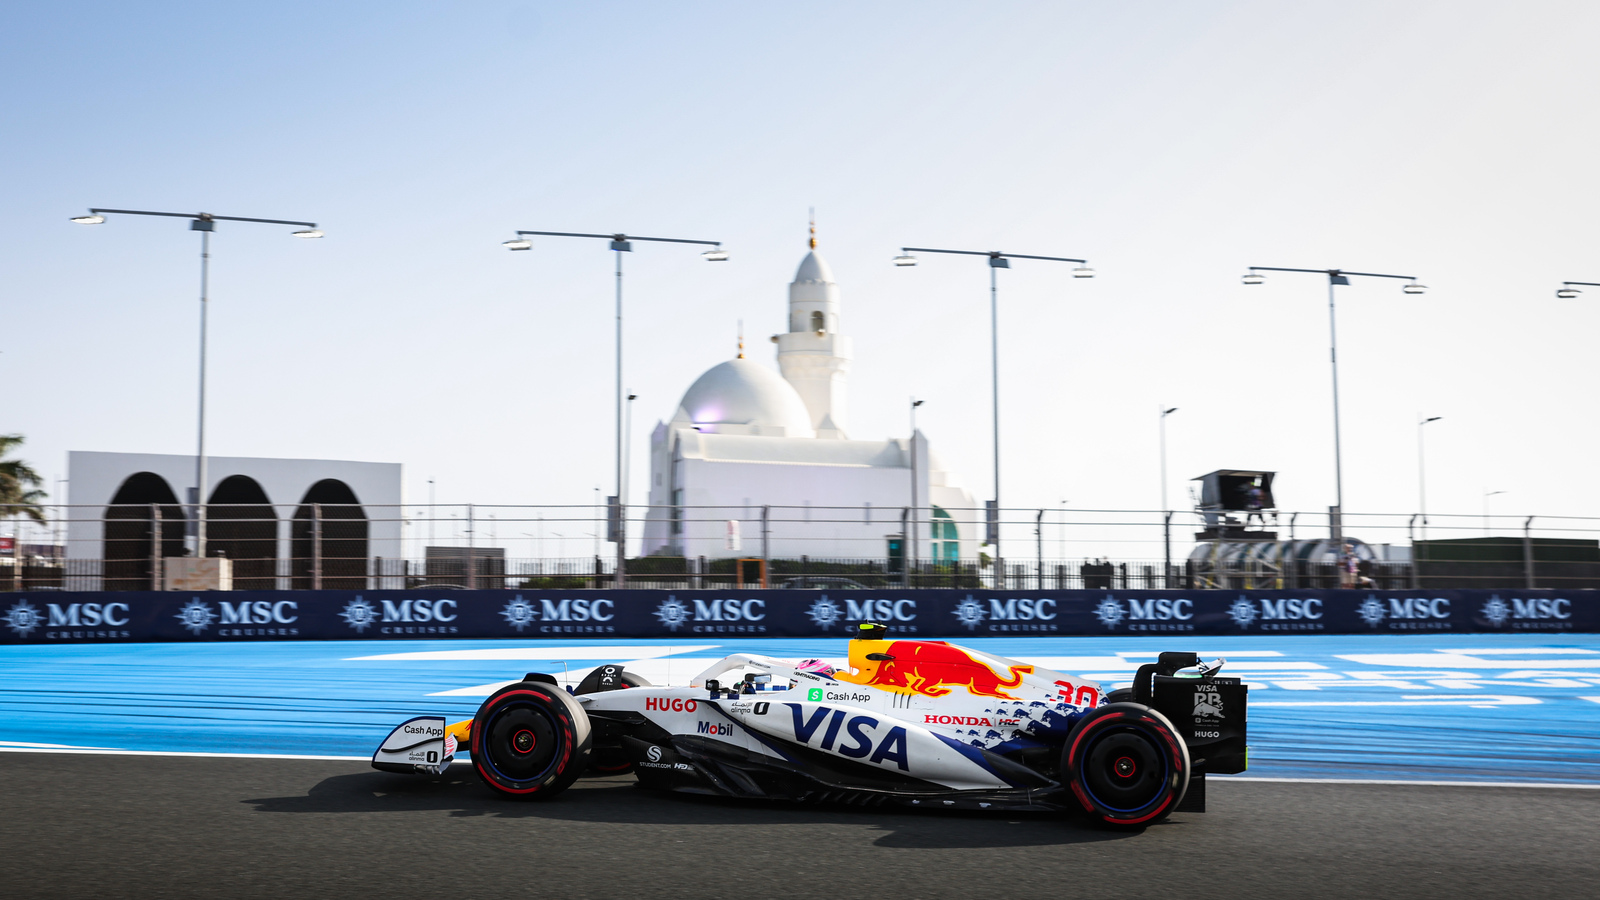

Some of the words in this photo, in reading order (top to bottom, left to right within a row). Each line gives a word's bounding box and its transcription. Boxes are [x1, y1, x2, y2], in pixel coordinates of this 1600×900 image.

[46, 603, 129, 626] MSC
[218, 601, 298, 624] MSC
[380, 599, 458, 622] MSC
[540, 599, 614, 621] MSC
[692, 599, 766, 621] MSC
[844, 600, 916, 621] MSC
[988, 599, 1057, 620] MSC
[1128, 599, 1193, 620] MSC
[1259, 599, 1322, 619] MSC
[1388, 598, 1450, 618] MSC
[1511, 598, 1571, 619] MSC
[826, 692, 850, 701] Cash
[850, 693, 871, 703] App
[1195, 684, 1218, 692] VISA
[645, 697, 698, 713] HUGO
[404, 725, 425, 734] Cash
[425, 726, 443, 736] App
[697, 720, 733, 737] Mobil
[924, 714, 993, 727] HONDA
[998, 718, 1021, 726] HRC
[782, 702, 910, 772] VISA
